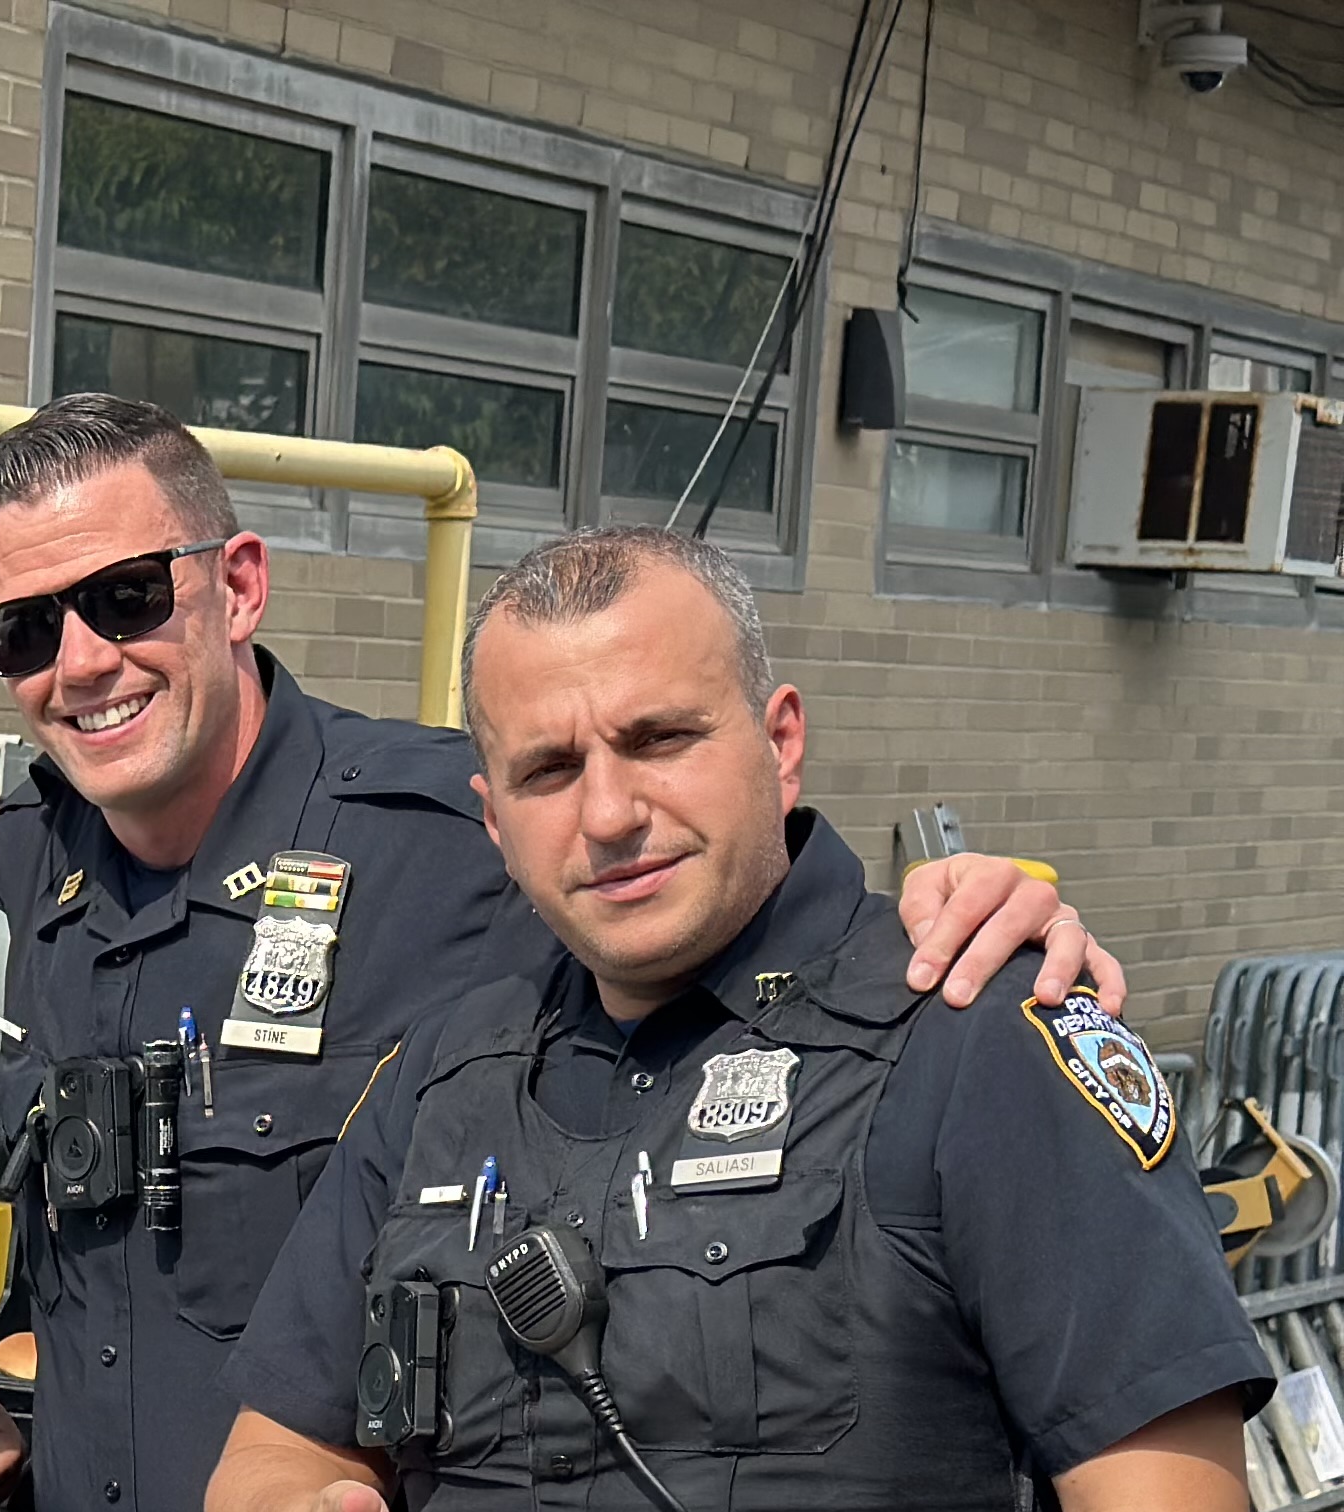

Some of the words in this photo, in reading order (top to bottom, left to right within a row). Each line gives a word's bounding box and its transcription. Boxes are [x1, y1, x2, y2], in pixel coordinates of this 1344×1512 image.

[246, 970, 314, 1003] 4849
[1067, 1058, 1111, 1100] CITY
[1108, 1101, 1133, 1129] OF
[701, 1099, 769, 1129] 8809
[695, 1156, 755, 1176] SALIASI
[497, 1242, 530, 1272] NYPD
